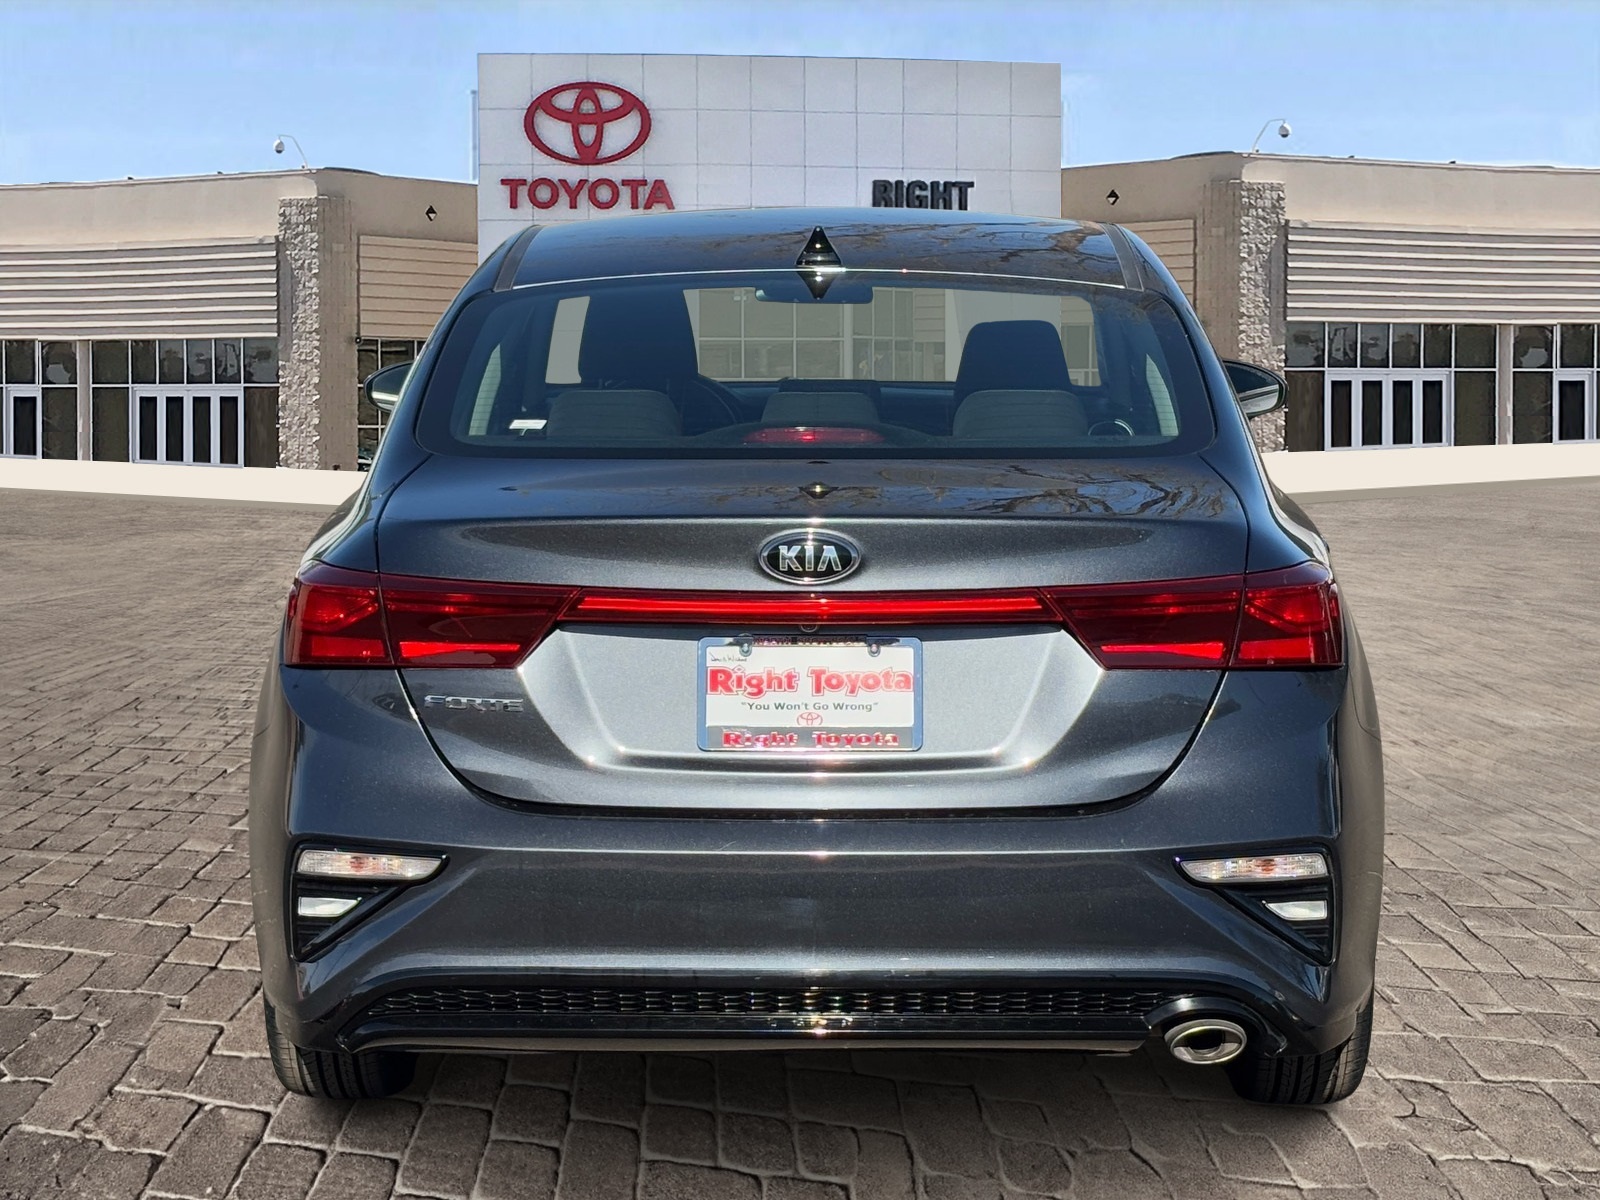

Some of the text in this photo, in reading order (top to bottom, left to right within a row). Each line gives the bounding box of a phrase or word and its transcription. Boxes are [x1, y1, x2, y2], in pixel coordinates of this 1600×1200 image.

[500, 178, 675, 210] TOYOTA
[872, 179, 974, 211] RIGHT
[779, 545, 842, 571] KIA
[708, 666, 913, 698] Right Toyota
[424, 695, 524, 712] FORTE
[774, 702, 808, 711] Won't
[812, 702, 829, 711] Go
[722, 730, 899, 748] Right Toyota
